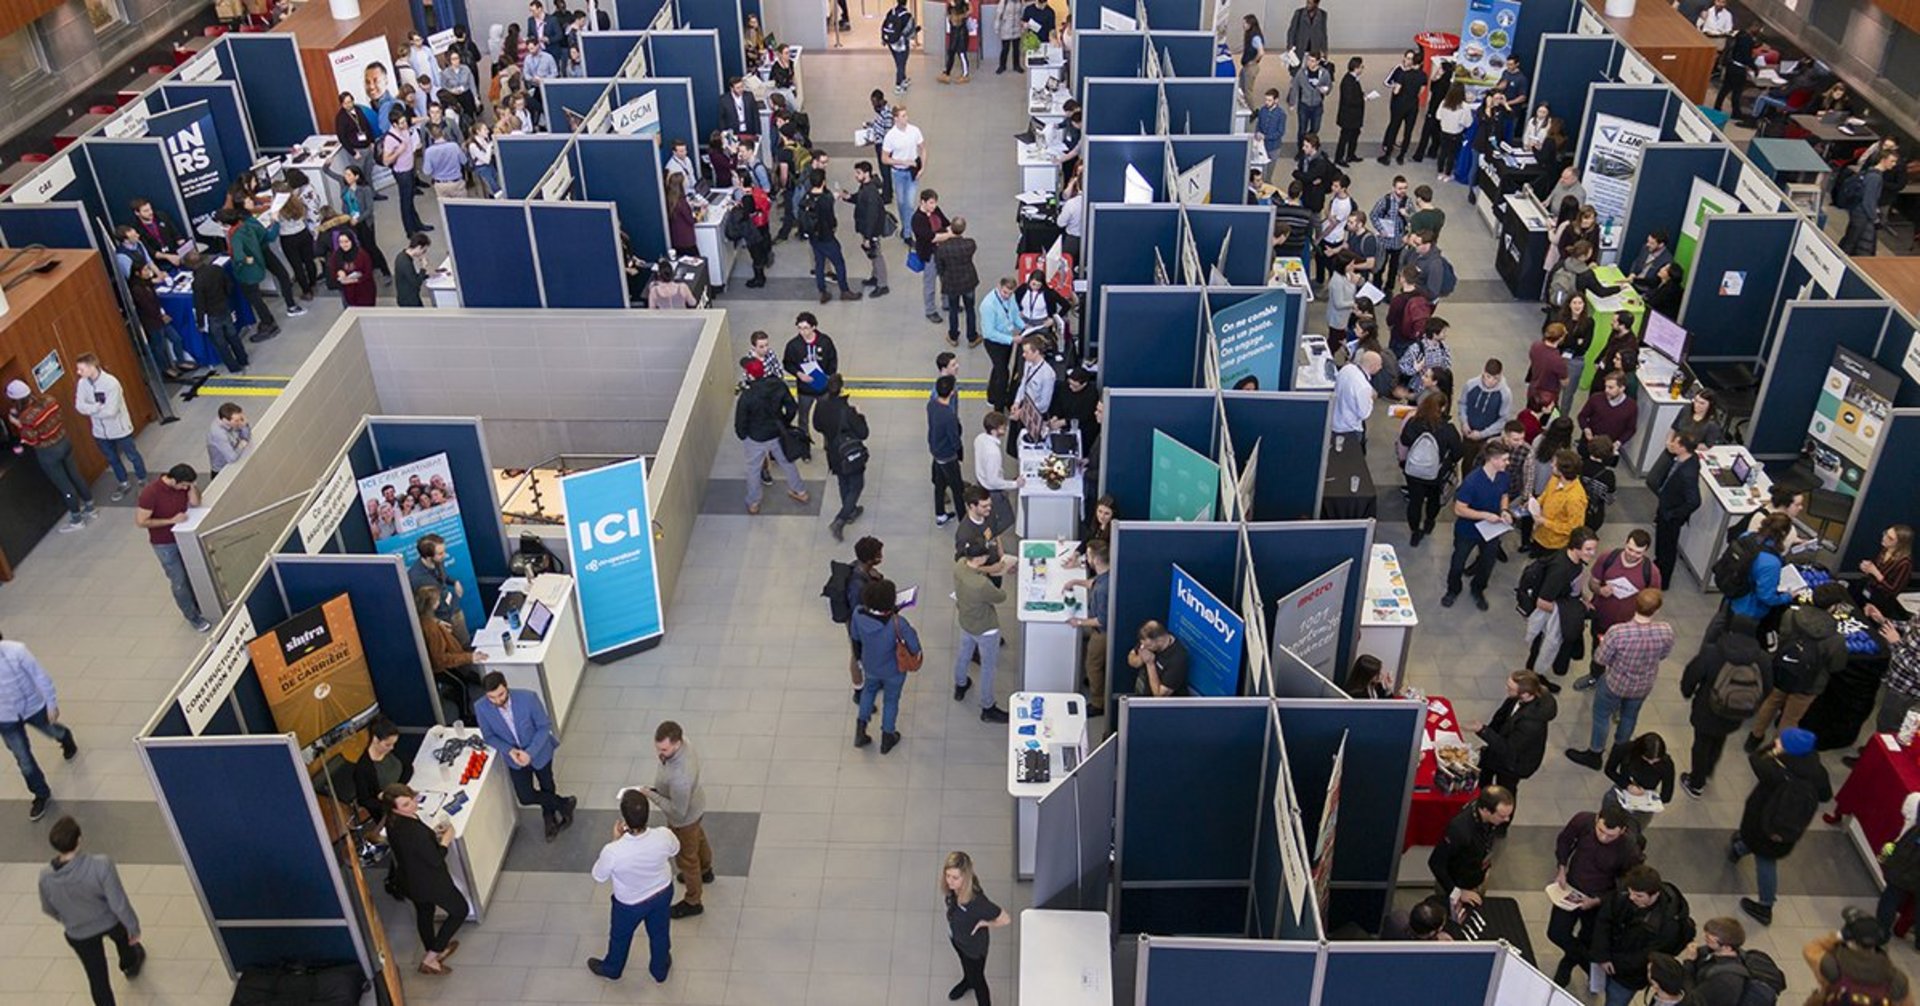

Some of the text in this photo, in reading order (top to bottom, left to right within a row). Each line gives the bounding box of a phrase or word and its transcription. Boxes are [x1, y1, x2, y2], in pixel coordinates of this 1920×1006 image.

[629, 103, 652, 121] GCM
[167, 121, 205, 154] IN
[172, 147, 211, 176] RS
[38, 179, 53, 195] CAE
[1221, 304, 1278, 333] On ne comble
[1220, 335, 1235, 348] pas
[1236, 330, 1247, 339] un
[1221, 334, 1265, 357] On engage
[1220, 358, 1235, 369] une
[578, 507, 641, 552] ICI
[1297, 581, 1334, 608] metro
[1177, 578, 1236, 643] kimoby
[278, 640, 349, 683] MON HORIZON
[281, 649, 350, 692] DE CARRIÈRE
[185, 645, 236, 715] CONSTRUCTION
[197, 671, 228, 713] DIVISION
